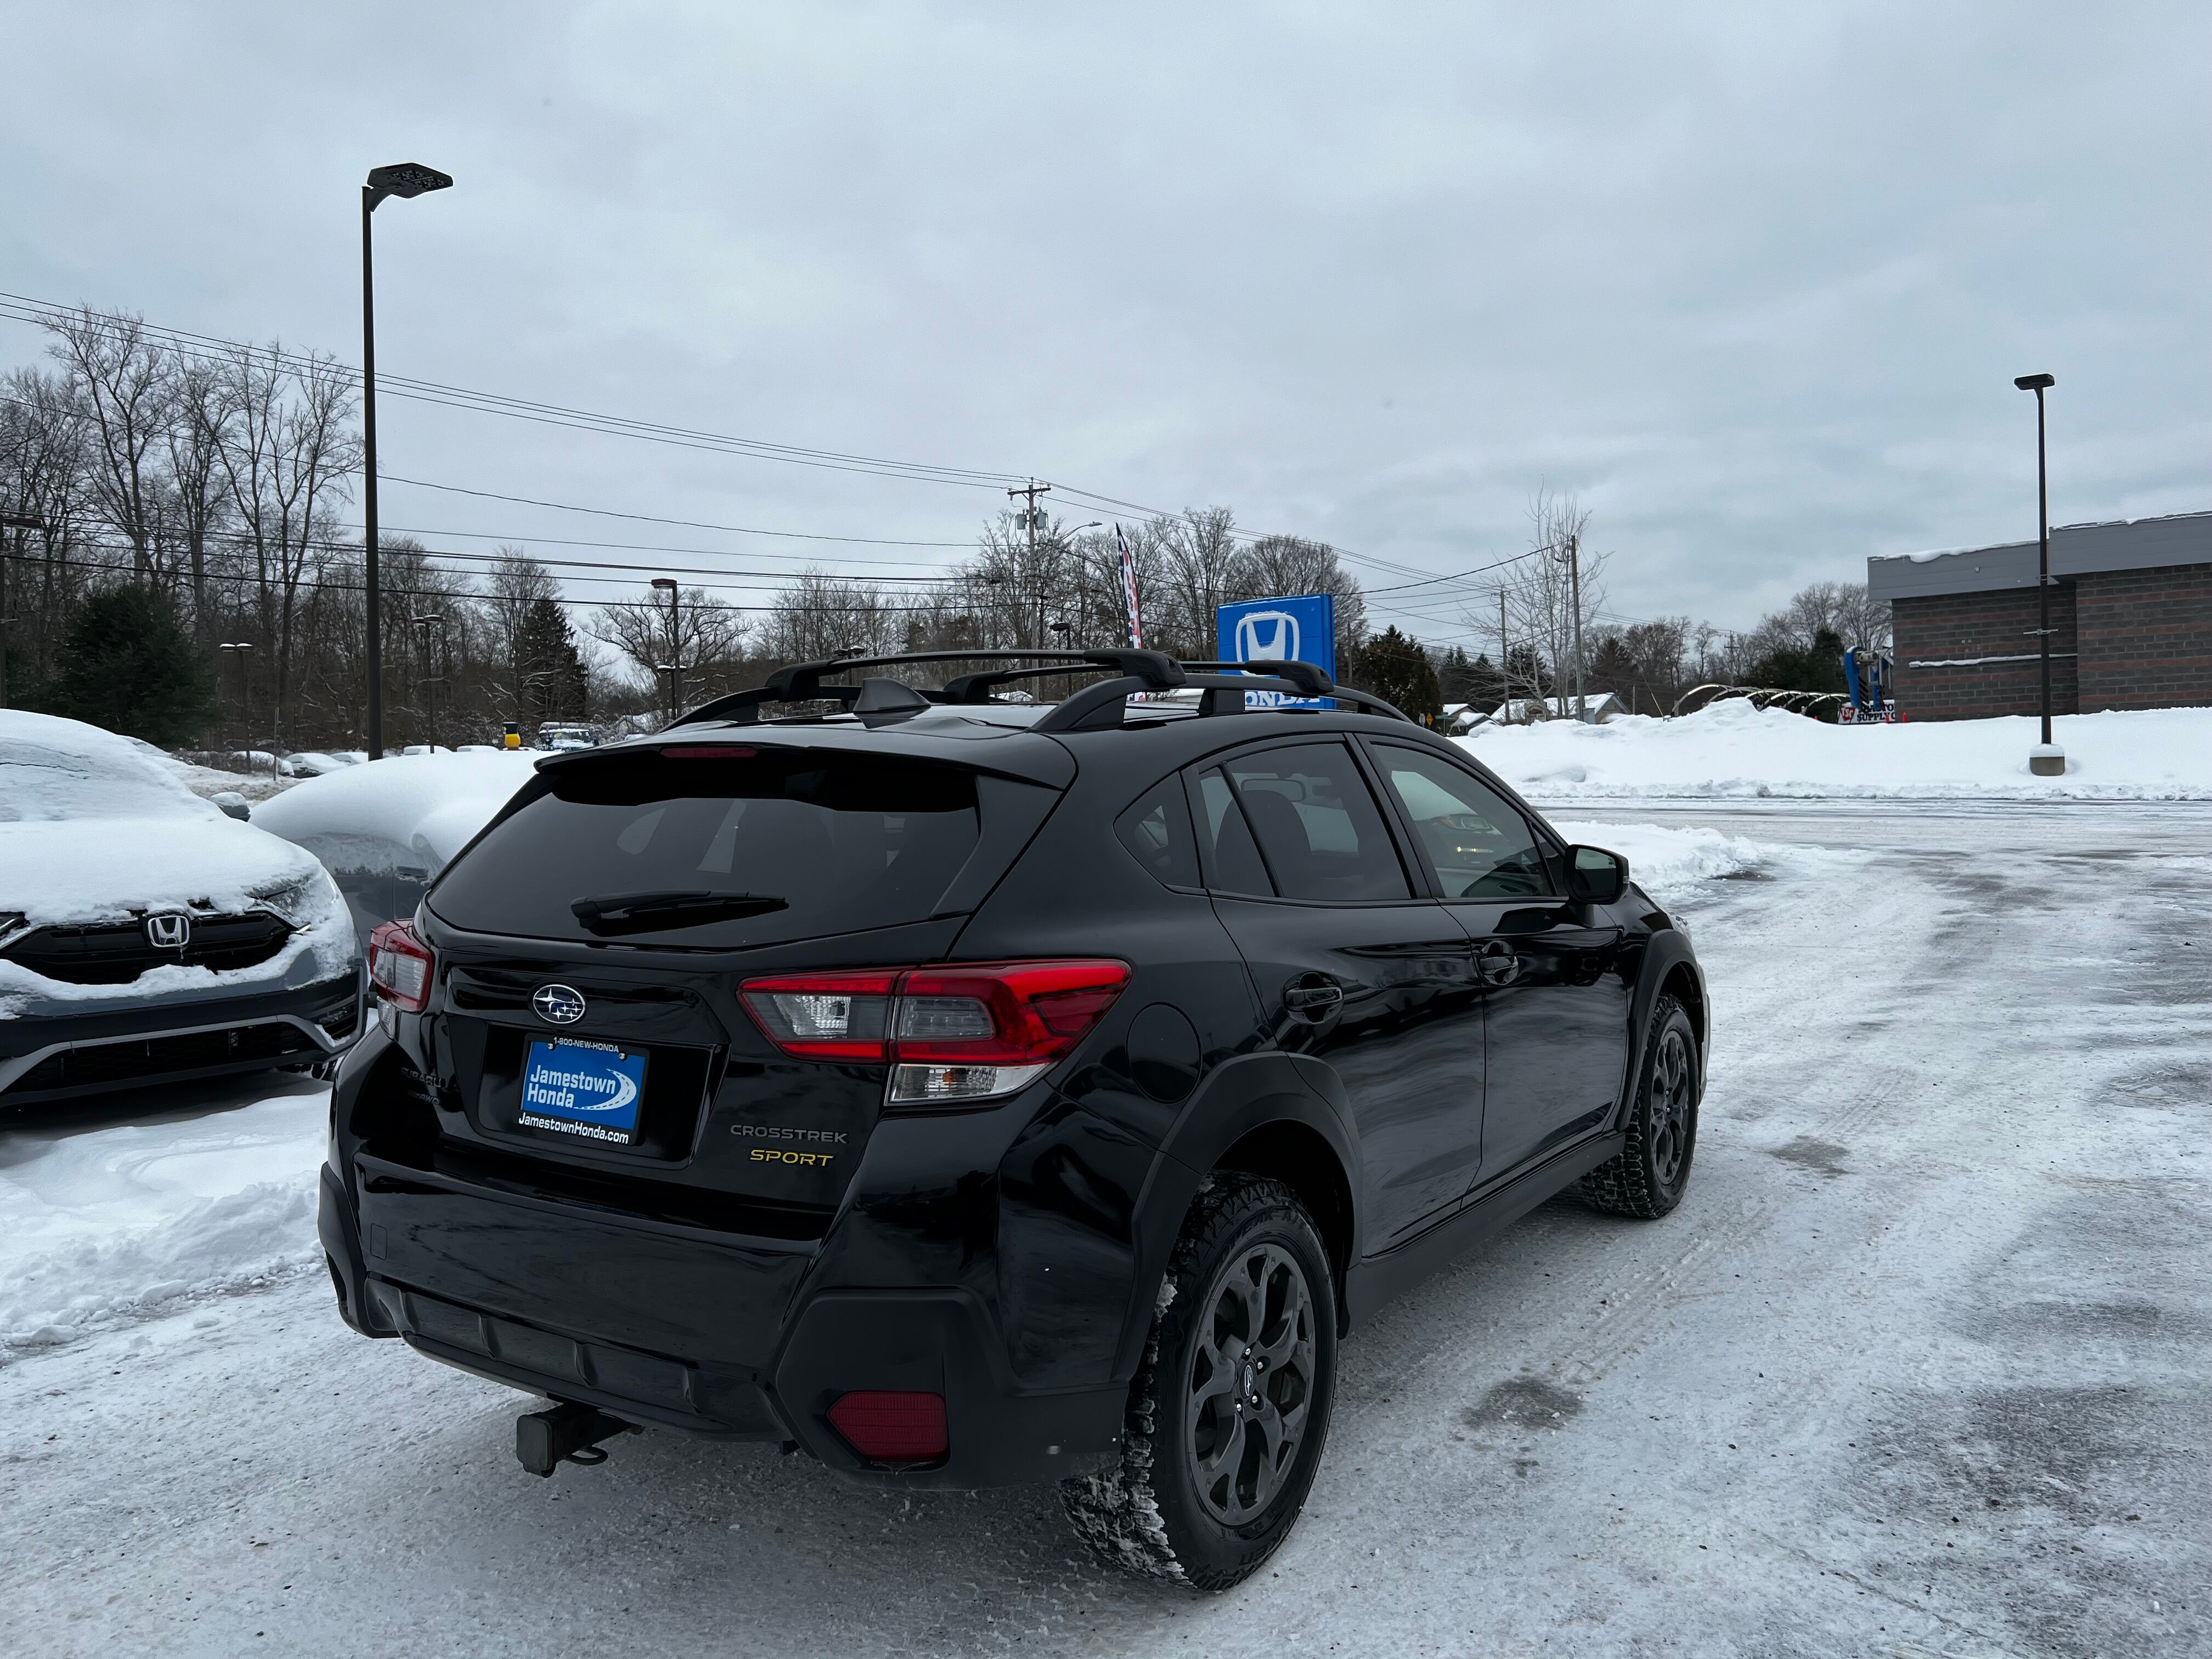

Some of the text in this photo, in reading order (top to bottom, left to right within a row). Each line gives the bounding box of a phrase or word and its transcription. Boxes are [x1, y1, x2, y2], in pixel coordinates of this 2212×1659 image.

[1245, 690, 1320, 707] OND
[554, 1037, 619, 1053] 1-800-NEW-HONDA
[531, 1065, 616, 1094] Jamestown
[527, 1083, 574, 1108] Honda
[518, 1112, 629, 1144] JamestownHonda.com
[730, 1125, 849, 1144] CROSSTREK
[750, 1149, 833, 1166] SPORT
